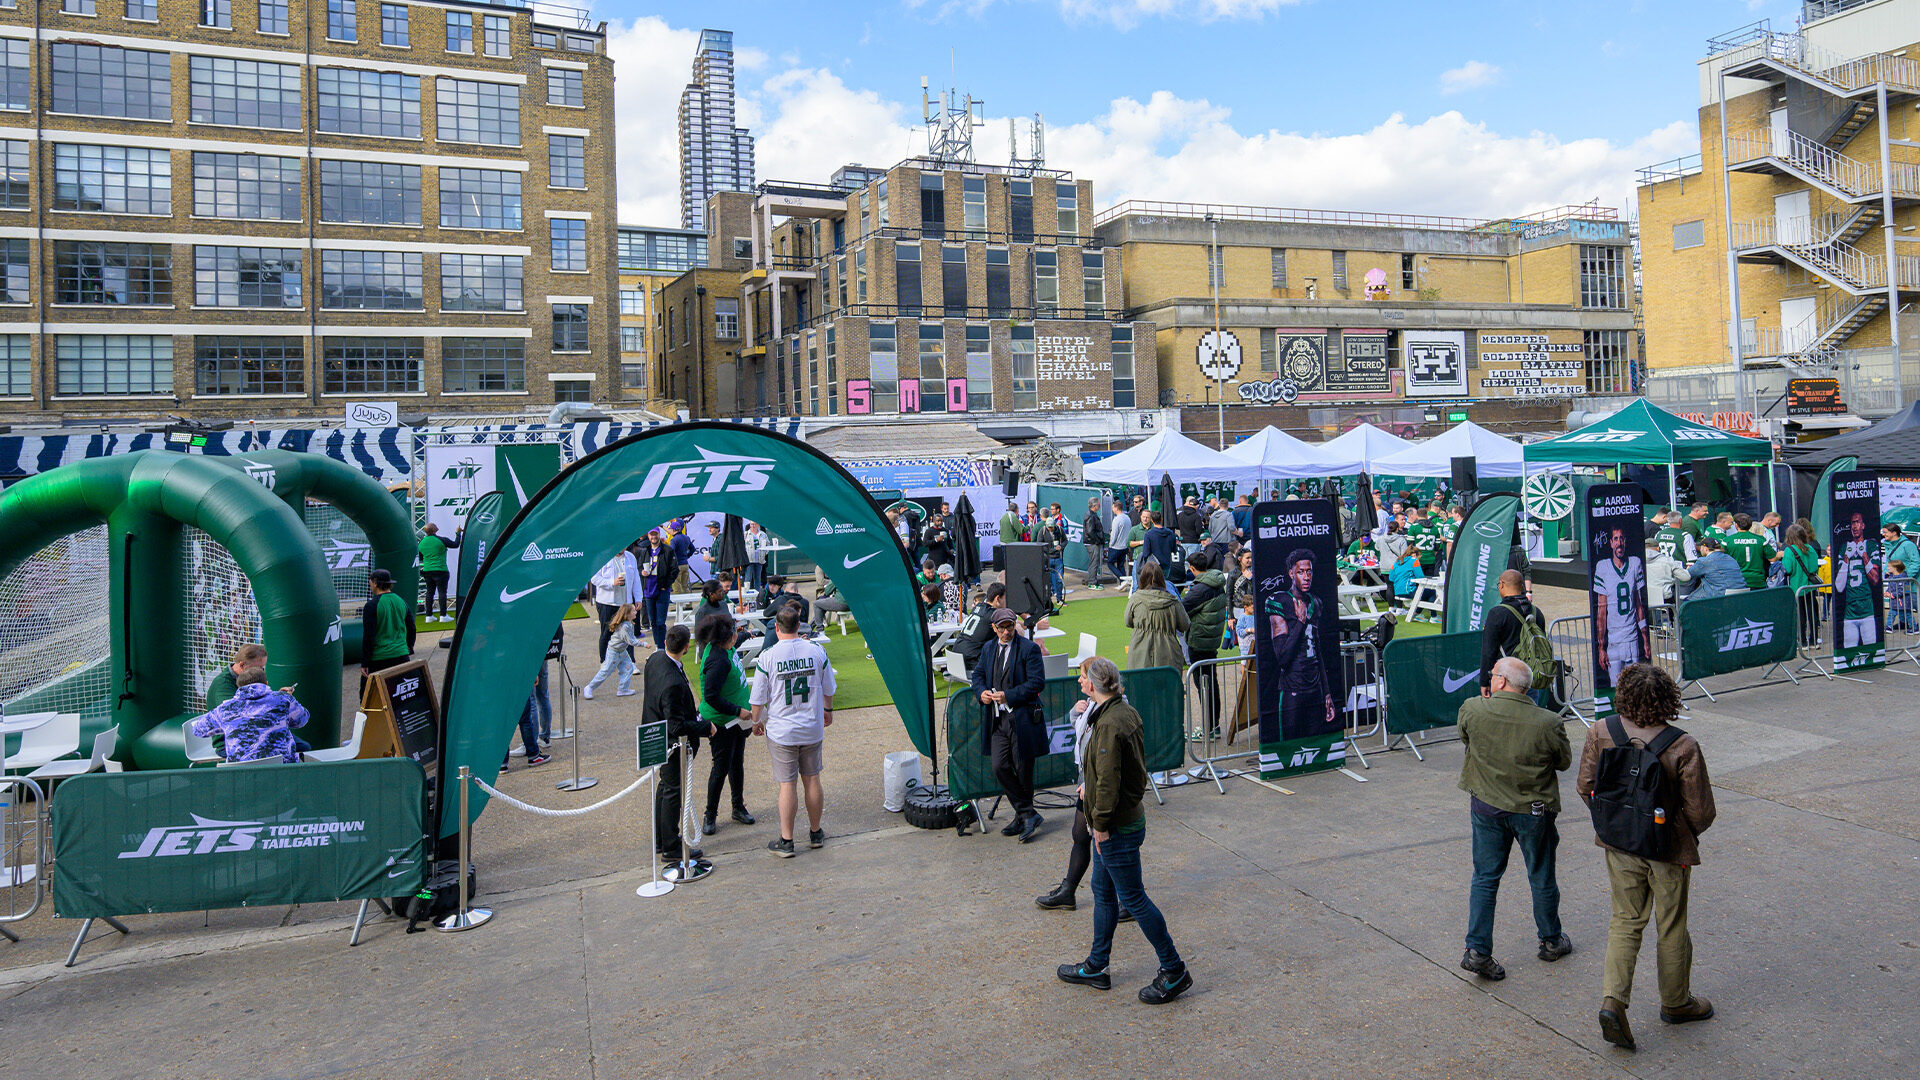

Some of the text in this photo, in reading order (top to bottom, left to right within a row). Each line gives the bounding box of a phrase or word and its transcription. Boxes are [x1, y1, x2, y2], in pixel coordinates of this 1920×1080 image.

[1037, 336, 1094, 345] HOTEL
[1037, 345, 1087, 354] ECHO
[1350, 344, 1381, 354] HI-FI
[1037, 354, 1089, 362] LIMA
[1351, 361, 1382, 369] STEREO
[1038, 362, 1111, 371] CHARLIE
[1038, 371, 1096, 380] HOTEL
[1238, 378, 1299, 403] DRUGS
[1516, 386, 1583, 395] PAINTING
[1712, 411, 1754, 429] GYROS
[1554, 428, 1648, 443] JETS
[1672, 425, 1729, 440] JETS
[617, 444, 777, 502] JETS
[1846, 480, 1876, 490] GARRETT
[1604, 495, 1632, 506] AARON
[1846, 488, 1873, 499] WILSON
[1605, 504, 1640, 517] RODGERS
[1262, 513, 1313, 525] CB SAUCE
[1278, 524, 1330, 537] GARDNER
[1415, 533, 1436, 551] 23
[544, 551, 585, 560] DENNISON
[545, 546, 570, 554] AVERY
[1745, 546, 1751, 562] 1
[1849, 559, 1863, 588] 5
[1469, 543, 1491, 631] FACE PAINTING
[1616, 581, 1631, 616] 8
[1718, 617, 1775, 653] JETS
[776, 657, 815, 673] DARNOLD
[392, 677, 420, 698] JETS
[784, 674, 811, 706] 14
[1289, 746, 1321, 768] NY
[117, 811, 266, 859] JETS
[269, 820, 365, 837] TOUCHDOWN
[262, 835, 330, 850] TAILGATE
